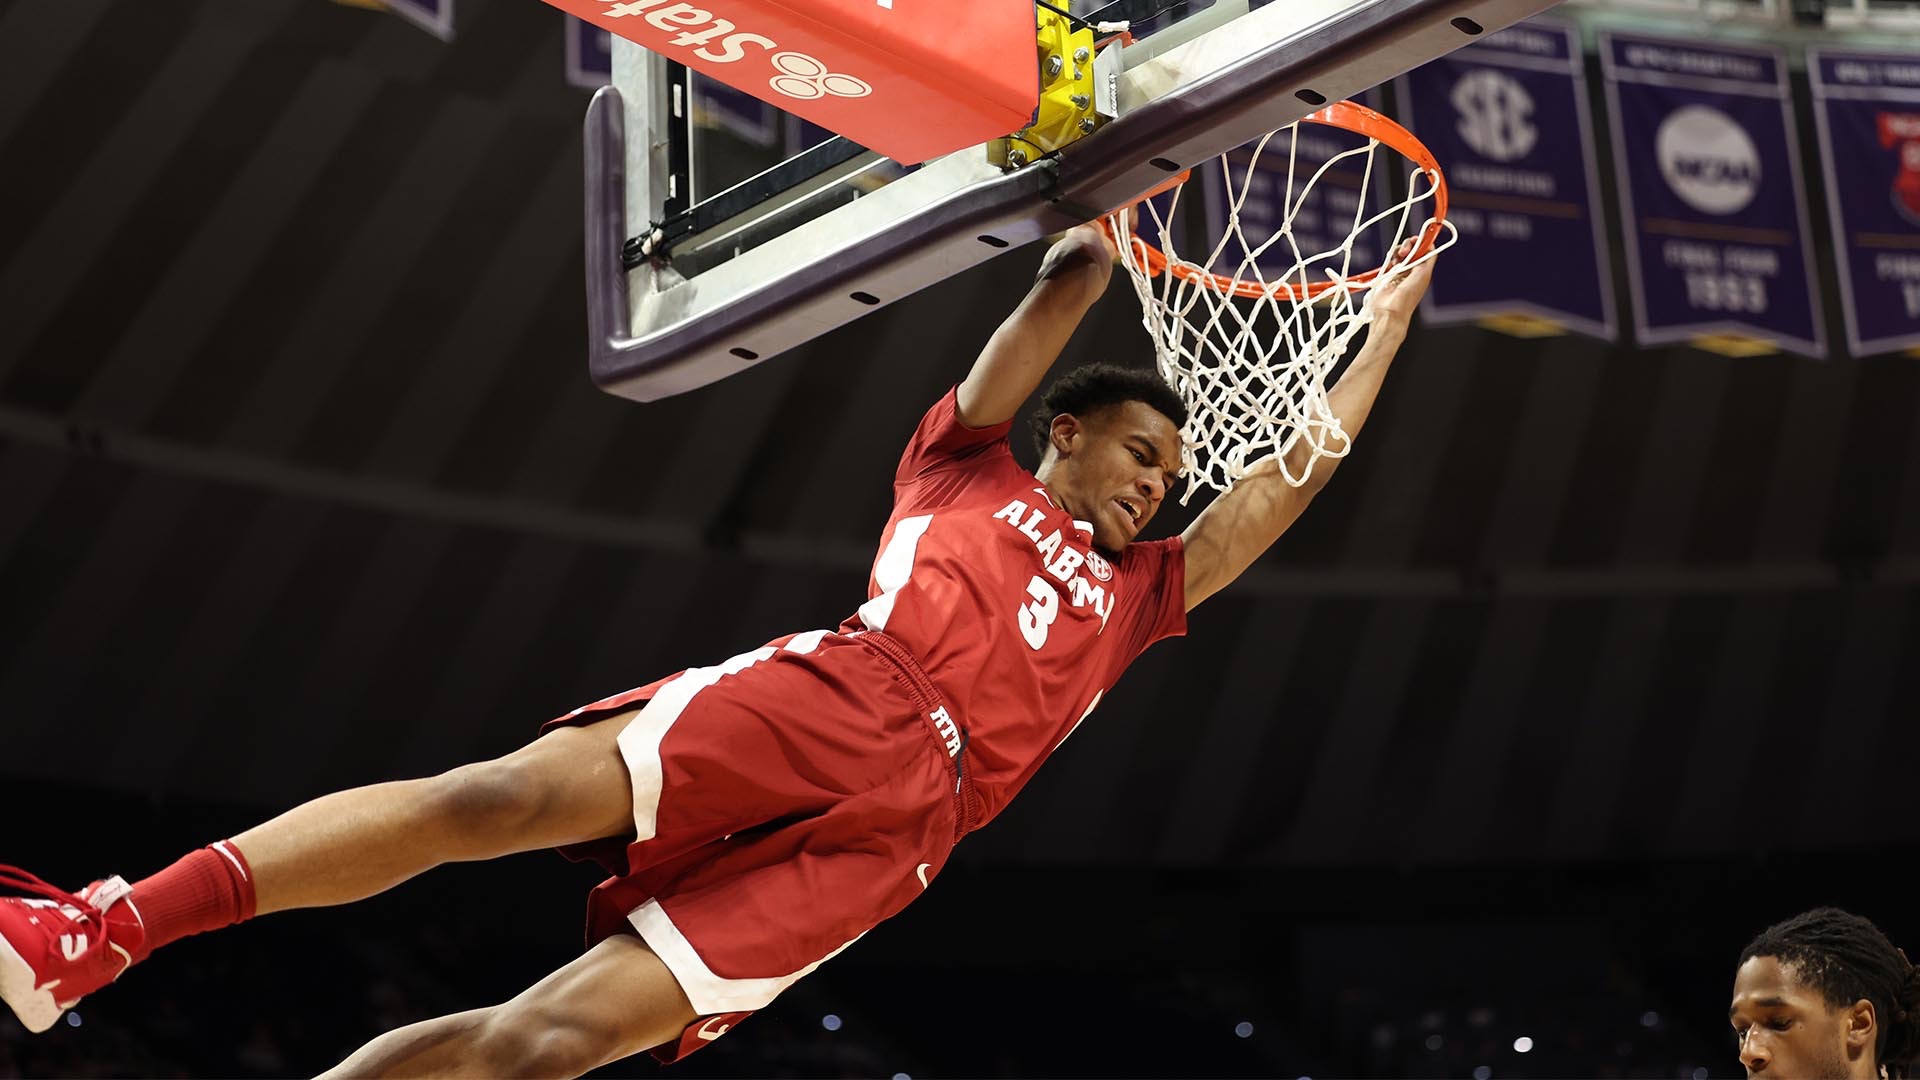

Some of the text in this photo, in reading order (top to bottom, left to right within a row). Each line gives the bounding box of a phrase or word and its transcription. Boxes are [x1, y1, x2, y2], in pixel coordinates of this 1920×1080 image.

[593, 0, 778, 63] Stat
[1017, 575, 1059, 651] 3
[929, 705, 961, 758] RTR
